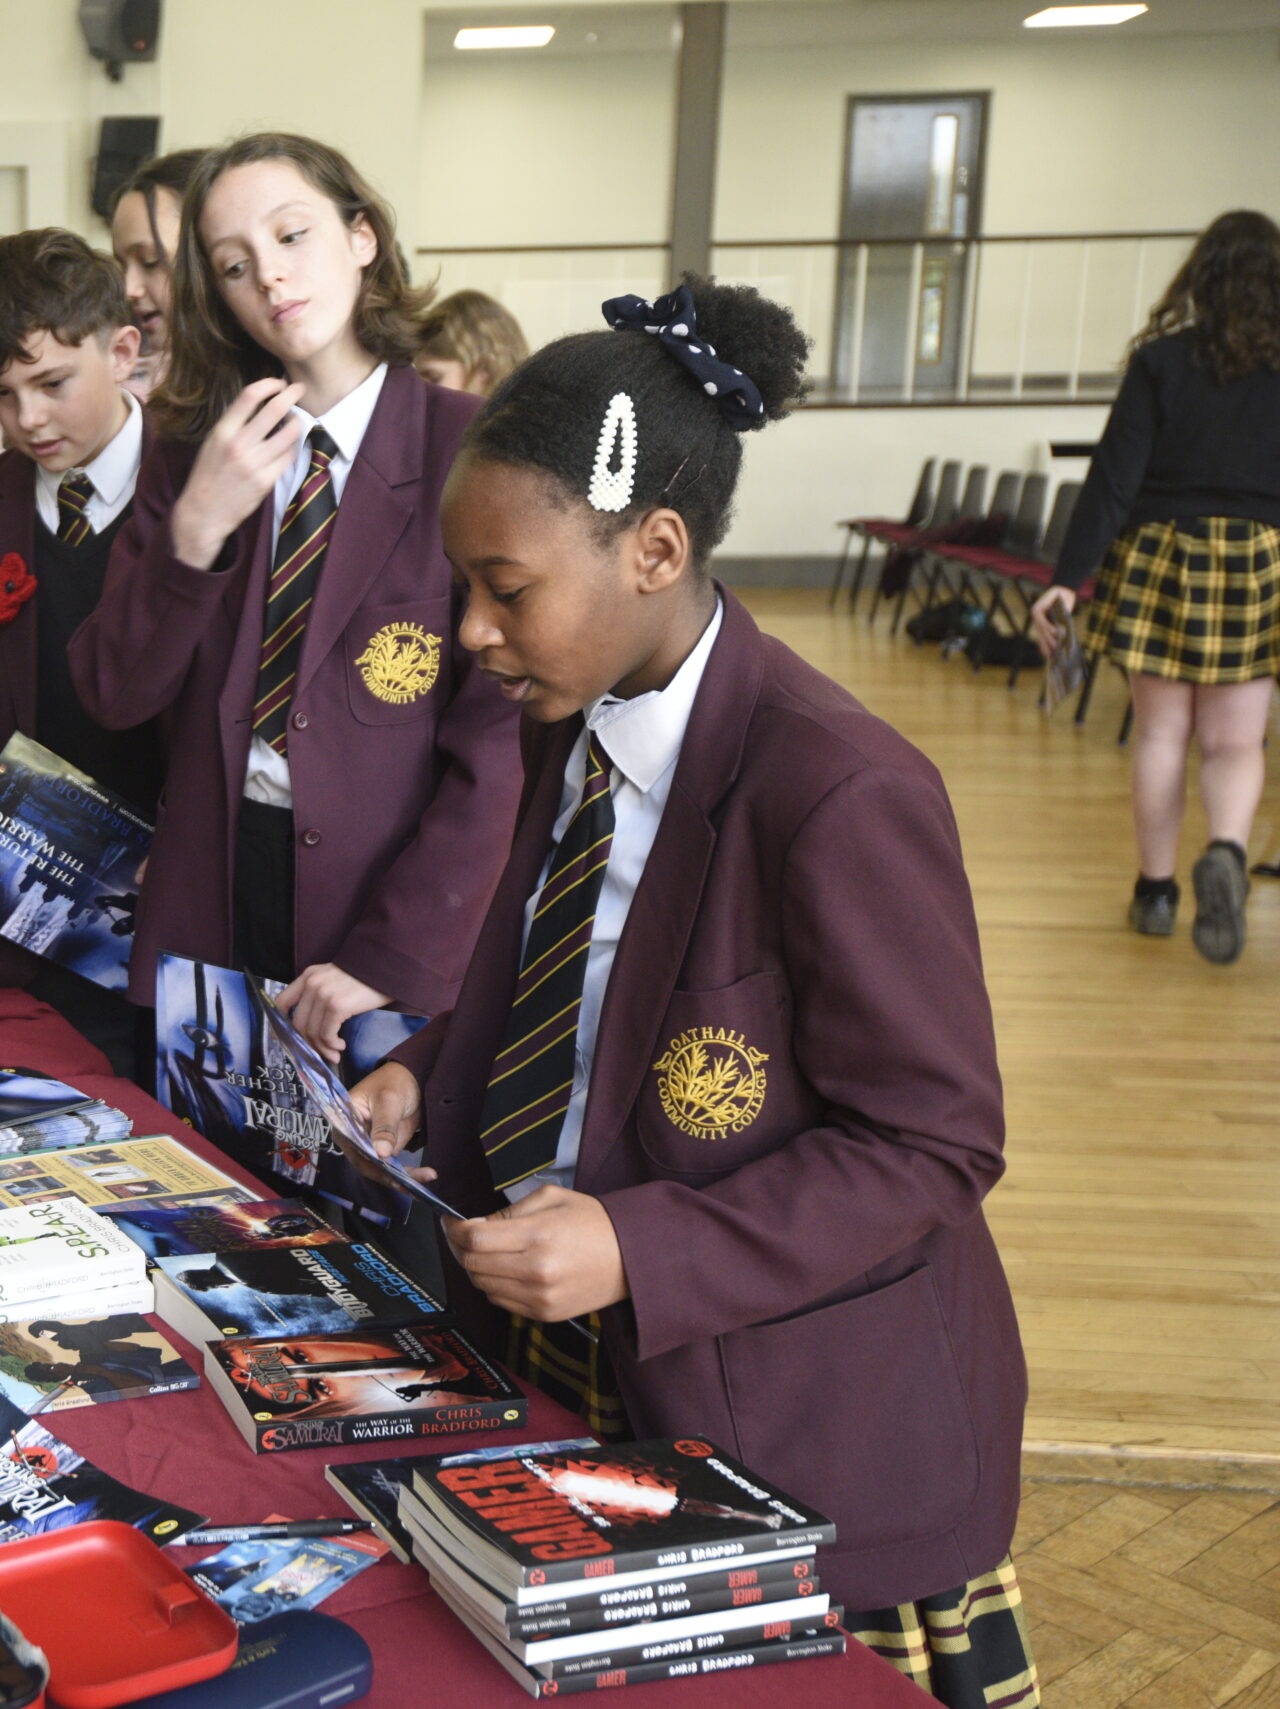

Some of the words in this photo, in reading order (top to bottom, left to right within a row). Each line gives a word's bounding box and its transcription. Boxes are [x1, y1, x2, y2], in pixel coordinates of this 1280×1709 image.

[368, 621, 424, 646] OATHALL
[361, 666, 416, 704] COMMUNITY
[57, 849, 85, 873] THE
[49, 865, 76, 887] THE
[670, 1026, 746, 1051] OATHALL
[224, 1072, 308, 1098] LETCHER
[657, 1077, 728, 1140] COMMUNITY
[731, 1068, 767, 1133] COLLEGE
[289, 1249, 376, 1322] BODYGUARD
[350, 1244, 437, 1312] BRADFORD
[353, 1262, 401, 1297] CHRIS
[243, 1346, 315, 1404] SAMURAI
[149, 1385, 170, 1394] Collins
[354, 1421, 368, 1429] THE
[370, 1418, 388, 1427] WAY
[399, 1416, 412, 1425] THE
[435, 1407, 482, 1422] CHRIS
[272, 1420, 345, 1449] SAMURAI
[352, 1424, 414, 1438] WARRIOR
[421, 1418, 501, 1435] BRADFORD
[706, 1457, 771, 1500] BRADFORD
[437, 1457, 615, 1561] GAMER
[767, 1499, 808, 1525] CHRIS
[584, 1559, 615, 1578] GAMER
[657, 1551, 687, 1566] CHRIS
[691, 1543, 745, 1562] BRADFORD
[776, 1534, 806, 1547] Barrington
[728, 1570, 758, 1587] GAMER
[600, 1586, 654, 1605] BRADFORD
[658, 1582, 687, 1596] CHRIS
[732, 1588, 762, 1605] GAMER
[535, 1602, 567, 1615] Barrington
[603, 1603, 658, 1622] BRADFORD
[662, 1599, 691, 1613] CHRIS
[539, 1618, 570, 1631] Barrington
[763, 1621, 792, 1639] GAMER
[642, 1640, 694, 1659] BRADFORD
[697, 1634, 725, 1648] CHRIS
[581, 1657, 611, 1669] Barrington
[596, 1669, 627, 1688] GAMER
[669, 1660, 698, 1676] CHRIS
[702, 1653, 755, 1673] BRADFORD
[787, 1645, 816, 1657] Barrington
